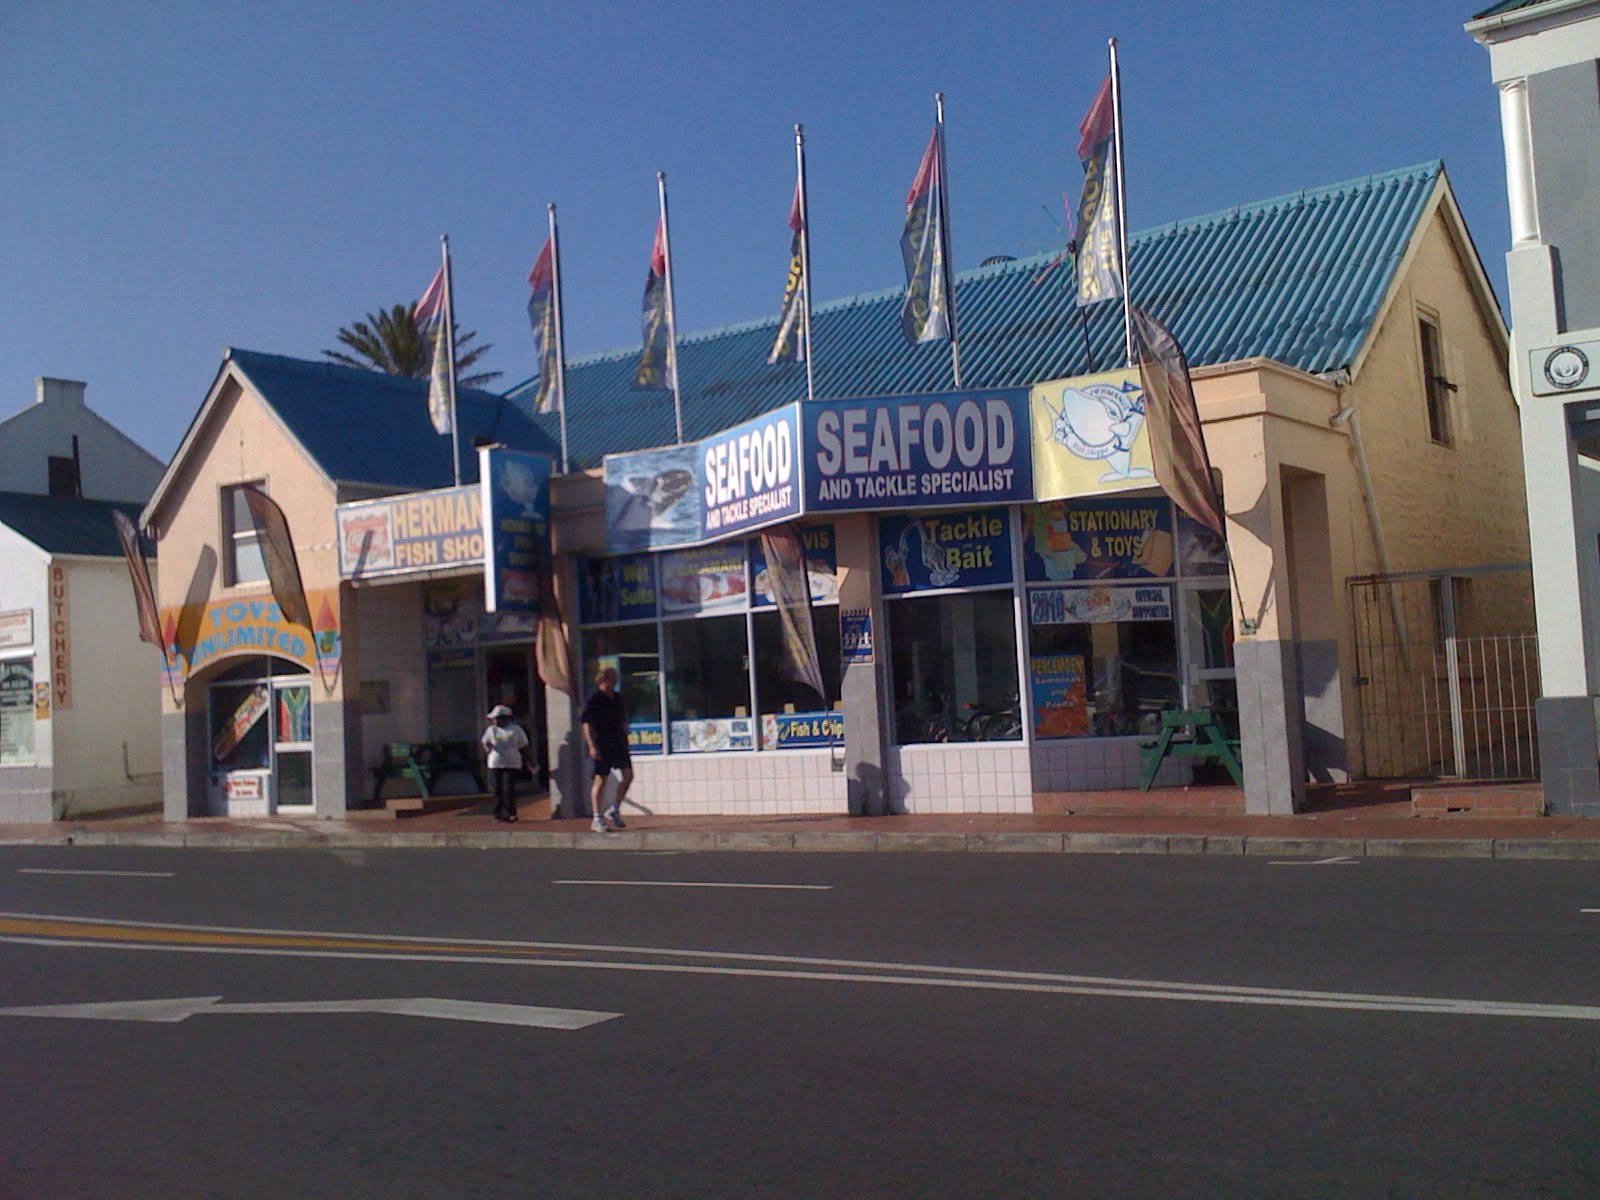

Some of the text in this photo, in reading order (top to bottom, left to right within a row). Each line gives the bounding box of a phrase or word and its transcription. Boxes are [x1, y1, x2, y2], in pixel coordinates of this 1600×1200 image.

[816, 399, 1014, 476] SEAFOOD
[704, 419, 791, 508] SEAFOOD
[819, 468, 1014, 500] AND TACKLE SPECIALIST
[705, 485, 791, 530] AND TACKLE SPECIALIST
[1069, 508, 1158, 532] STATIONARY
[803, 531, 829, 551] VIS
[924, 515, 1002, 542] Tackle
[394, 540, 438, 567] FISH
[945, 545, 993, 569] Bait
[1091, 534, 1143, 559] & TOYS
[208, 600, 282, 629] TOYS
[1032, 591, 1065, 622] 2010
[53, 567, 68, 704] BUTCHERY
[187, 626, 306, 667] UNLIMITED
[790, 720, 810, 738] Fish
[812, 720, 820, 737] &
